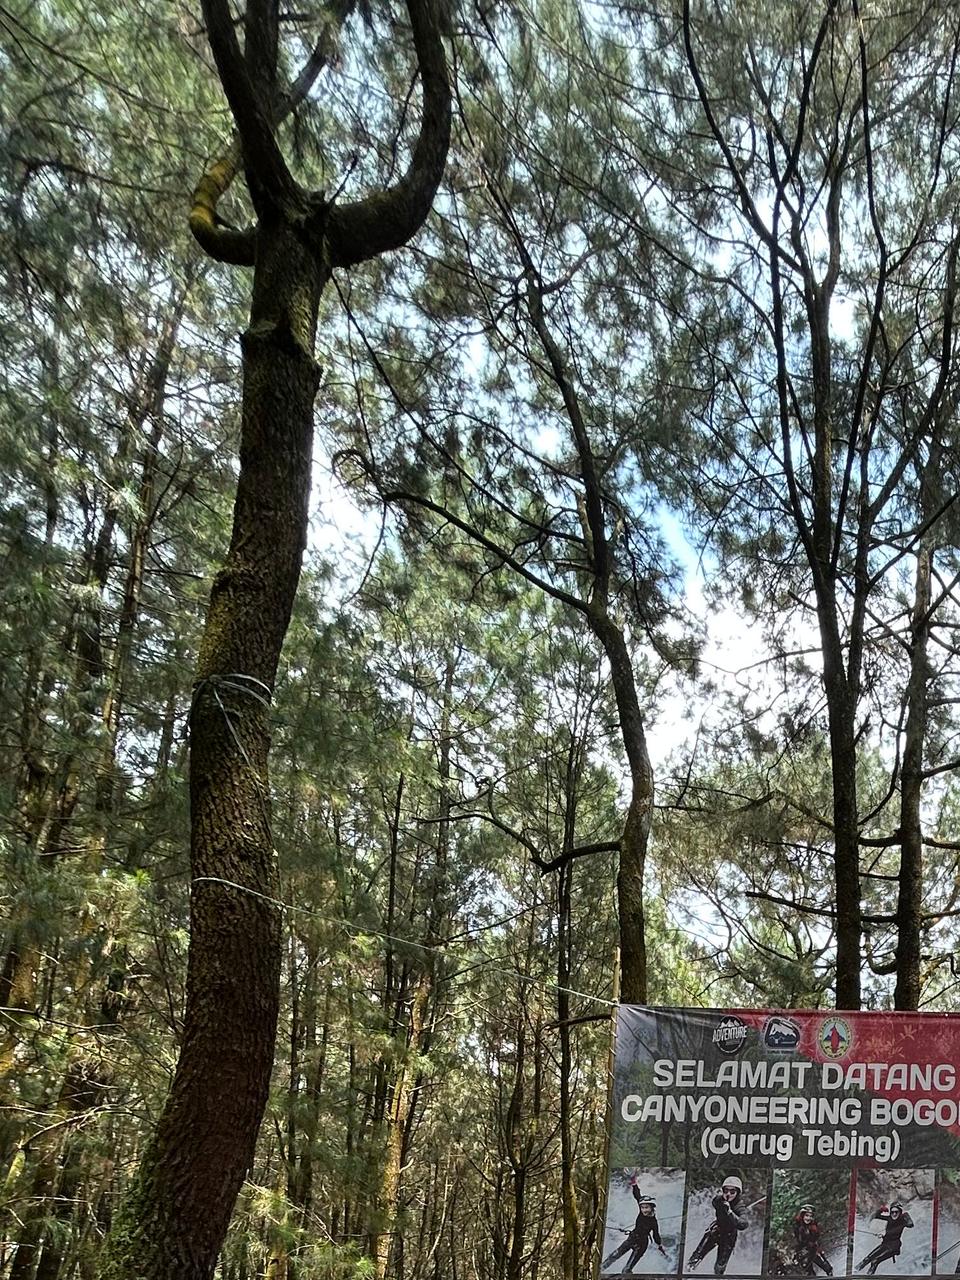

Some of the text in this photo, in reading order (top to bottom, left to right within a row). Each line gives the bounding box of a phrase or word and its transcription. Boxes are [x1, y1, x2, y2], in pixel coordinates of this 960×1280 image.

[712, 1025, 748, 1042] ADVENTURE
[652, 1059, 956, 1092] SELAMAT DATANG
[621, 1094, 862, 1125] CANYONEERING
[700, 1126, 901, 1163] (Curug Tebing)
